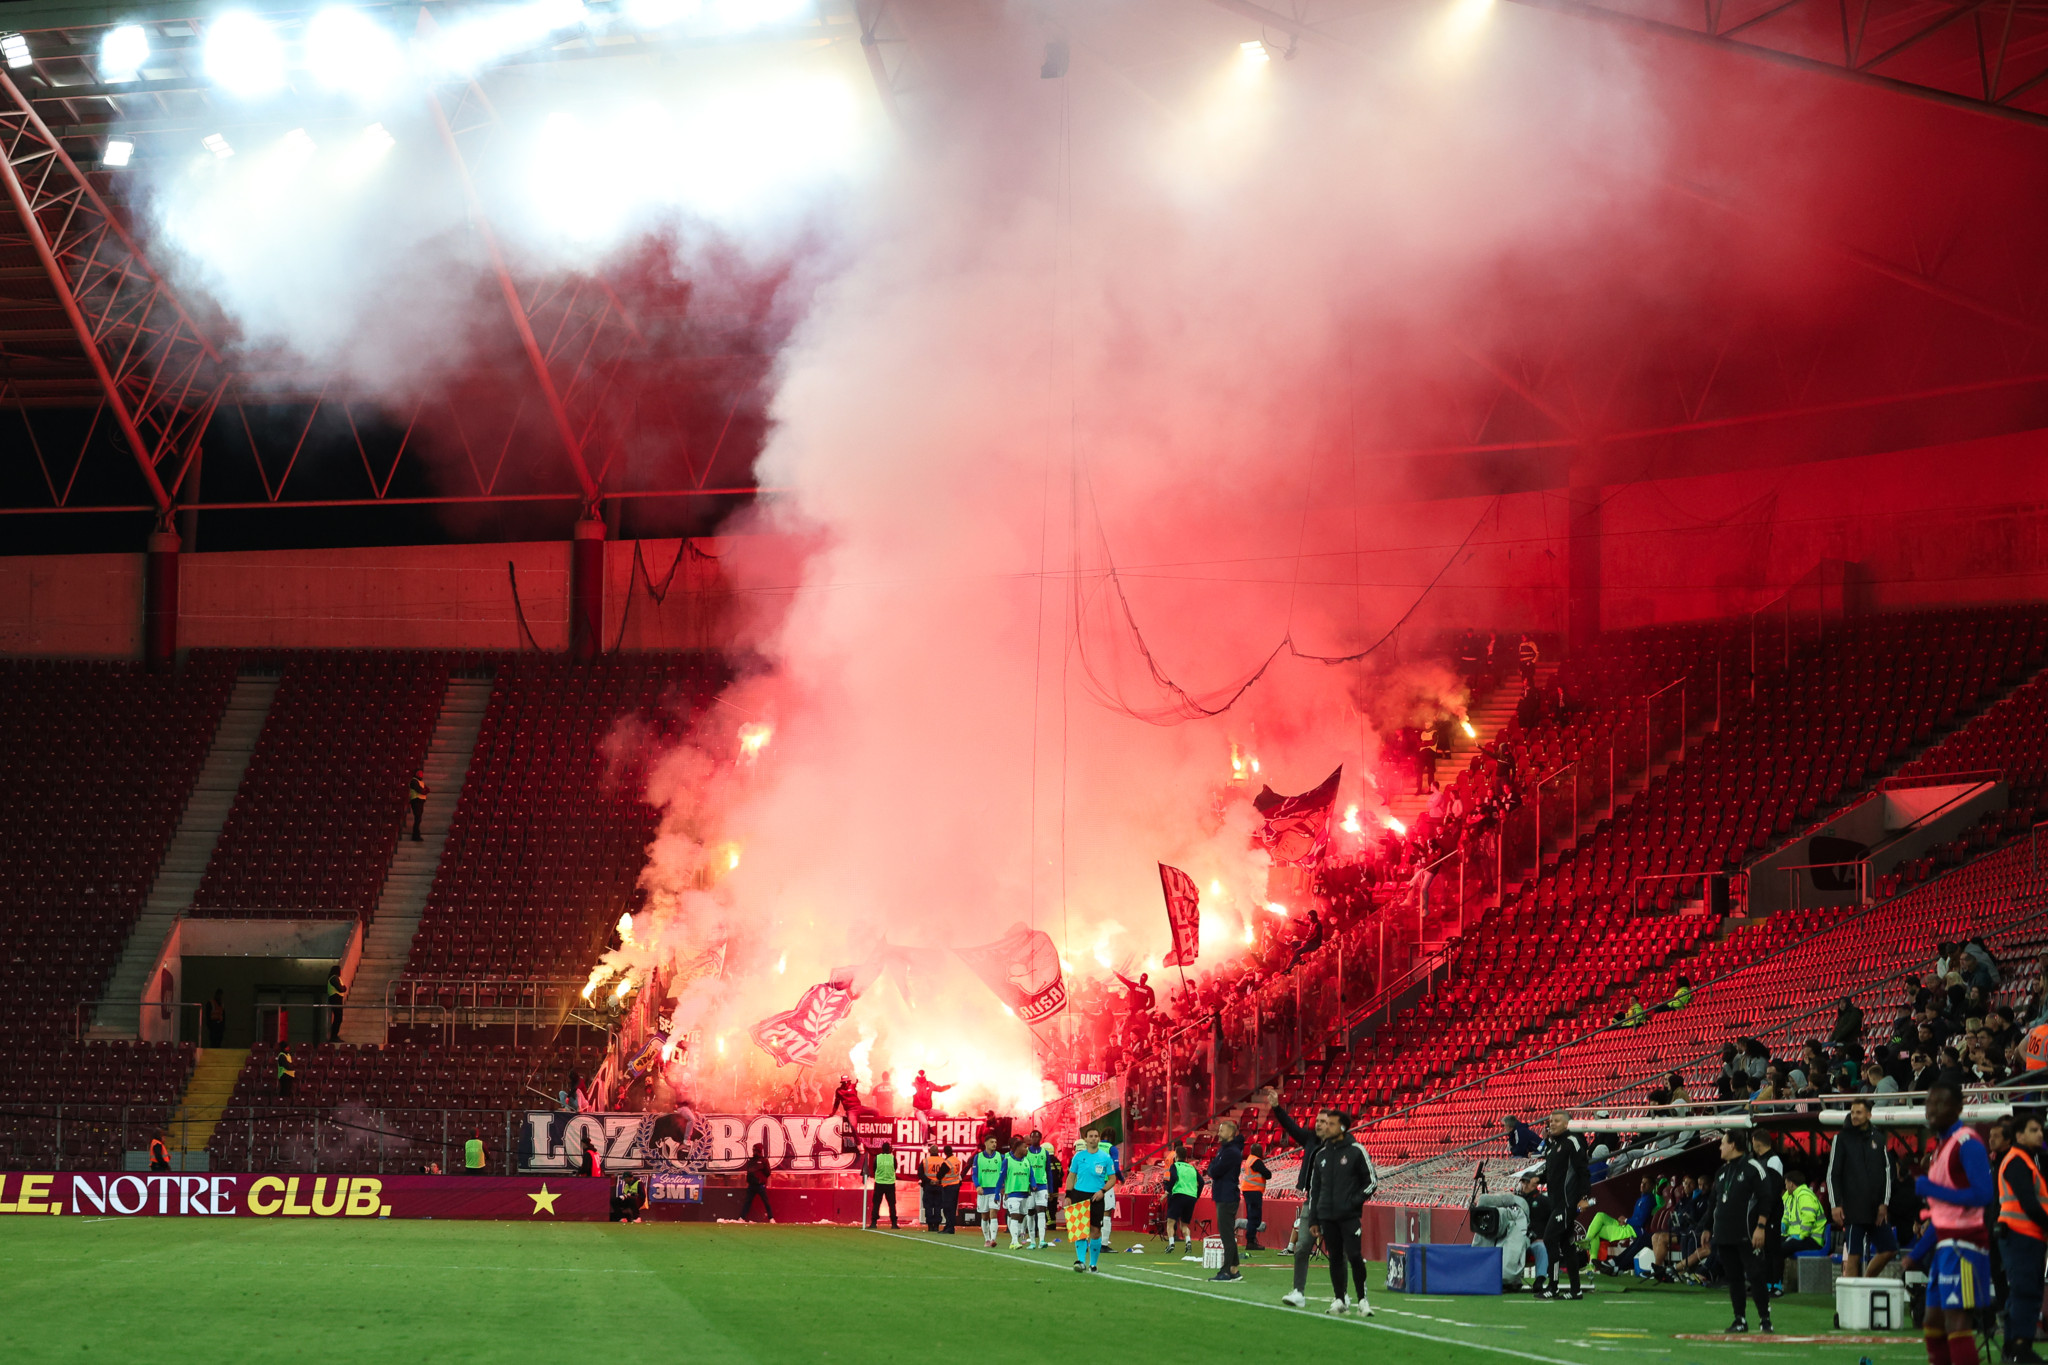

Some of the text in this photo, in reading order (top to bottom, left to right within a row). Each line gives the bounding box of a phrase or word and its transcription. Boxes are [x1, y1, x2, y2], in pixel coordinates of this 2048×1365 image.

[1067, 1072, 1078, 1085] ON
[528, 1113, 856, 1170] LOZ BOYS
[659, 1173, 694, 1183] Section
[72, 1175, 237, 1214] NOTRE
[247, 1176, 392, 1217] CLUB.
[652, 1183, 700, 1200] 3MT
